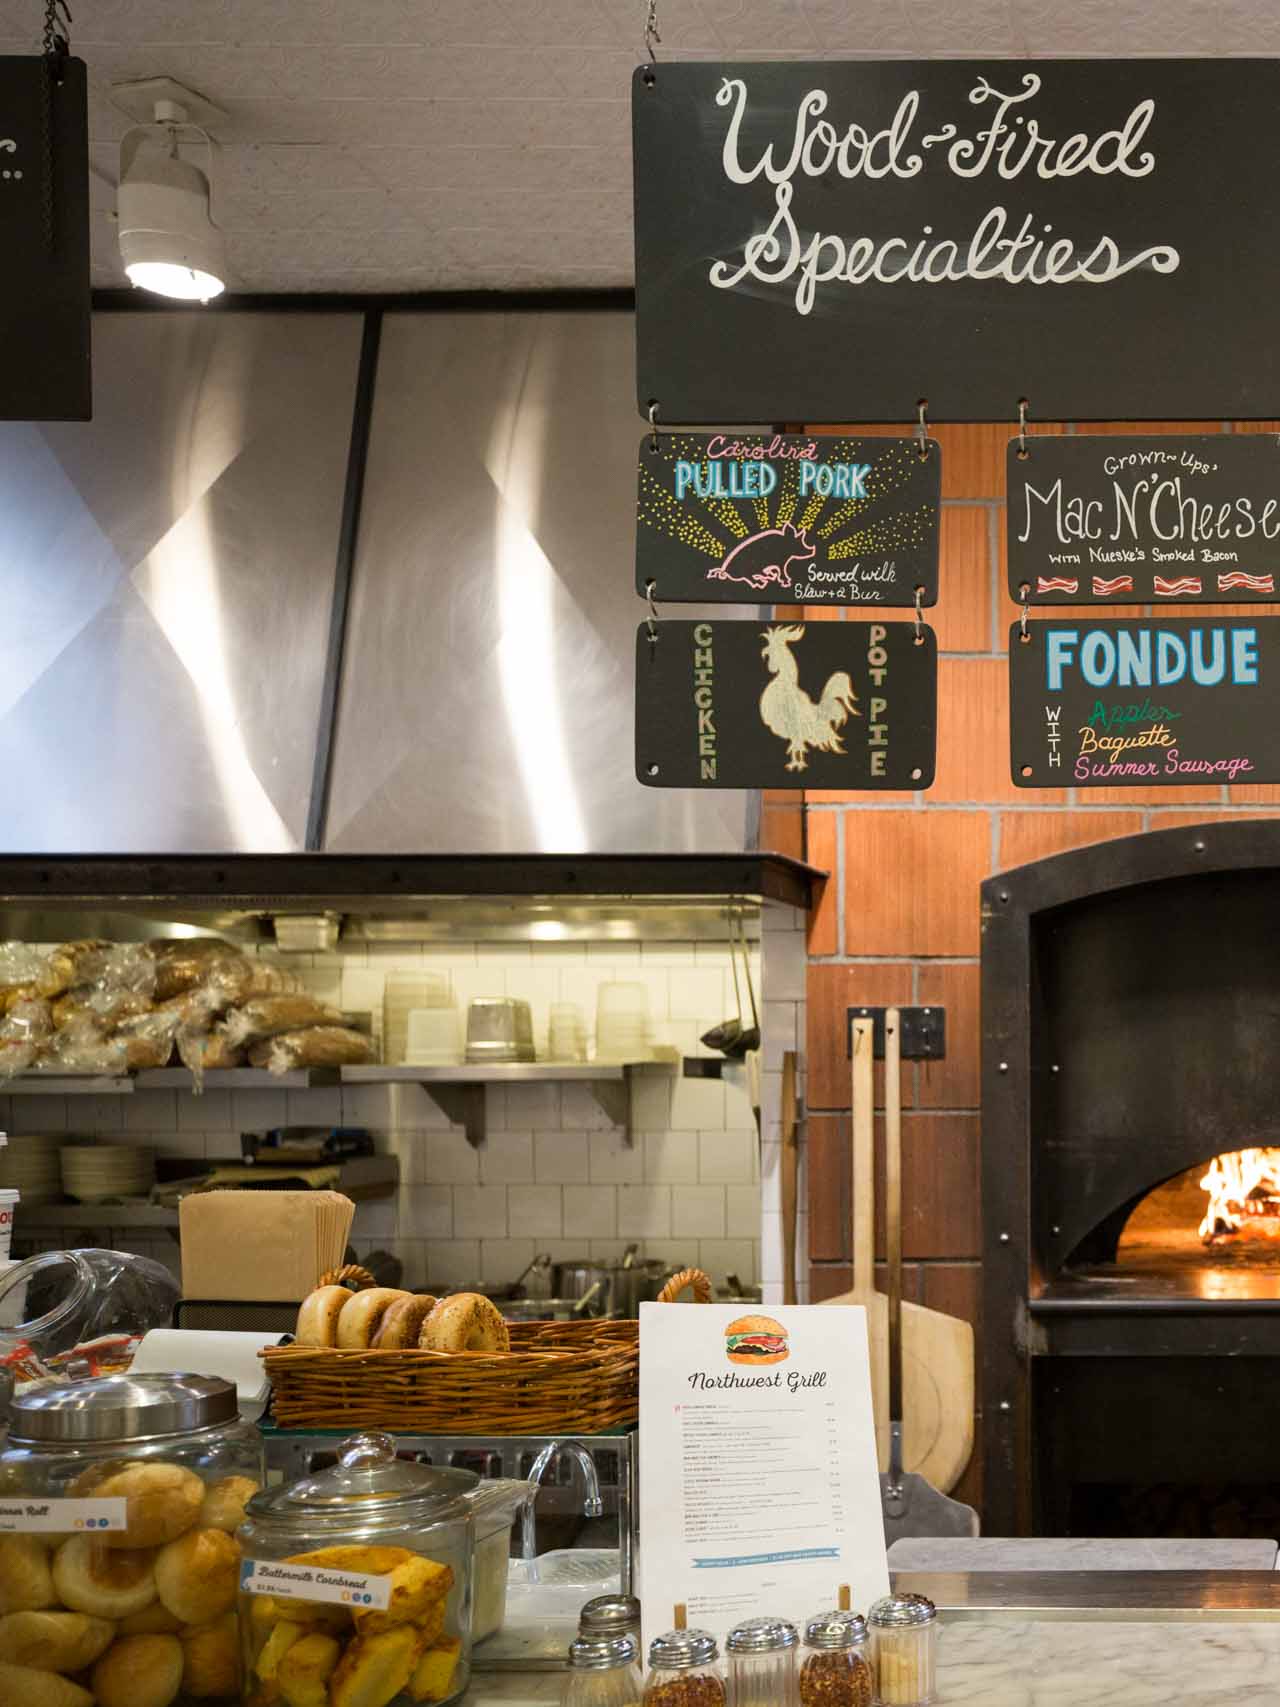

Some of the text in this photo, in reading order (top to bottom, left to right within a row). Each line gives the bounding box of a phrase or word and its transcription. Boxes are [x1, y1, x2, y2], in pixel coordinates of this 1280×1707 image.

[709, 181, 1180, 315] Specialties
[707, 434, 818, 460] Carolina
[675, 460, 872, 500] PULLED PORK
[1018, 479, 1103, 543] Mac
[808, 563, 857, 582] Served
[1089, 547, 1145, 562] Nueske's
[1152, 548, 1195, 562] Smoked
[1200, 549, 1238, 562] Bacon
[1047, 627, 1258, 690] FONDUE
[694, 624, 716, 780] CHICKEN
[867, 625, 888, 777] POT PIE
[1045, 706, 1061, 768] WITH
[1079, 724, 1177, 762] Baguette
[1074, 749, 1253, 780] Summer Sausage
[688, 1372, 827, 1393] Northwest Grill
